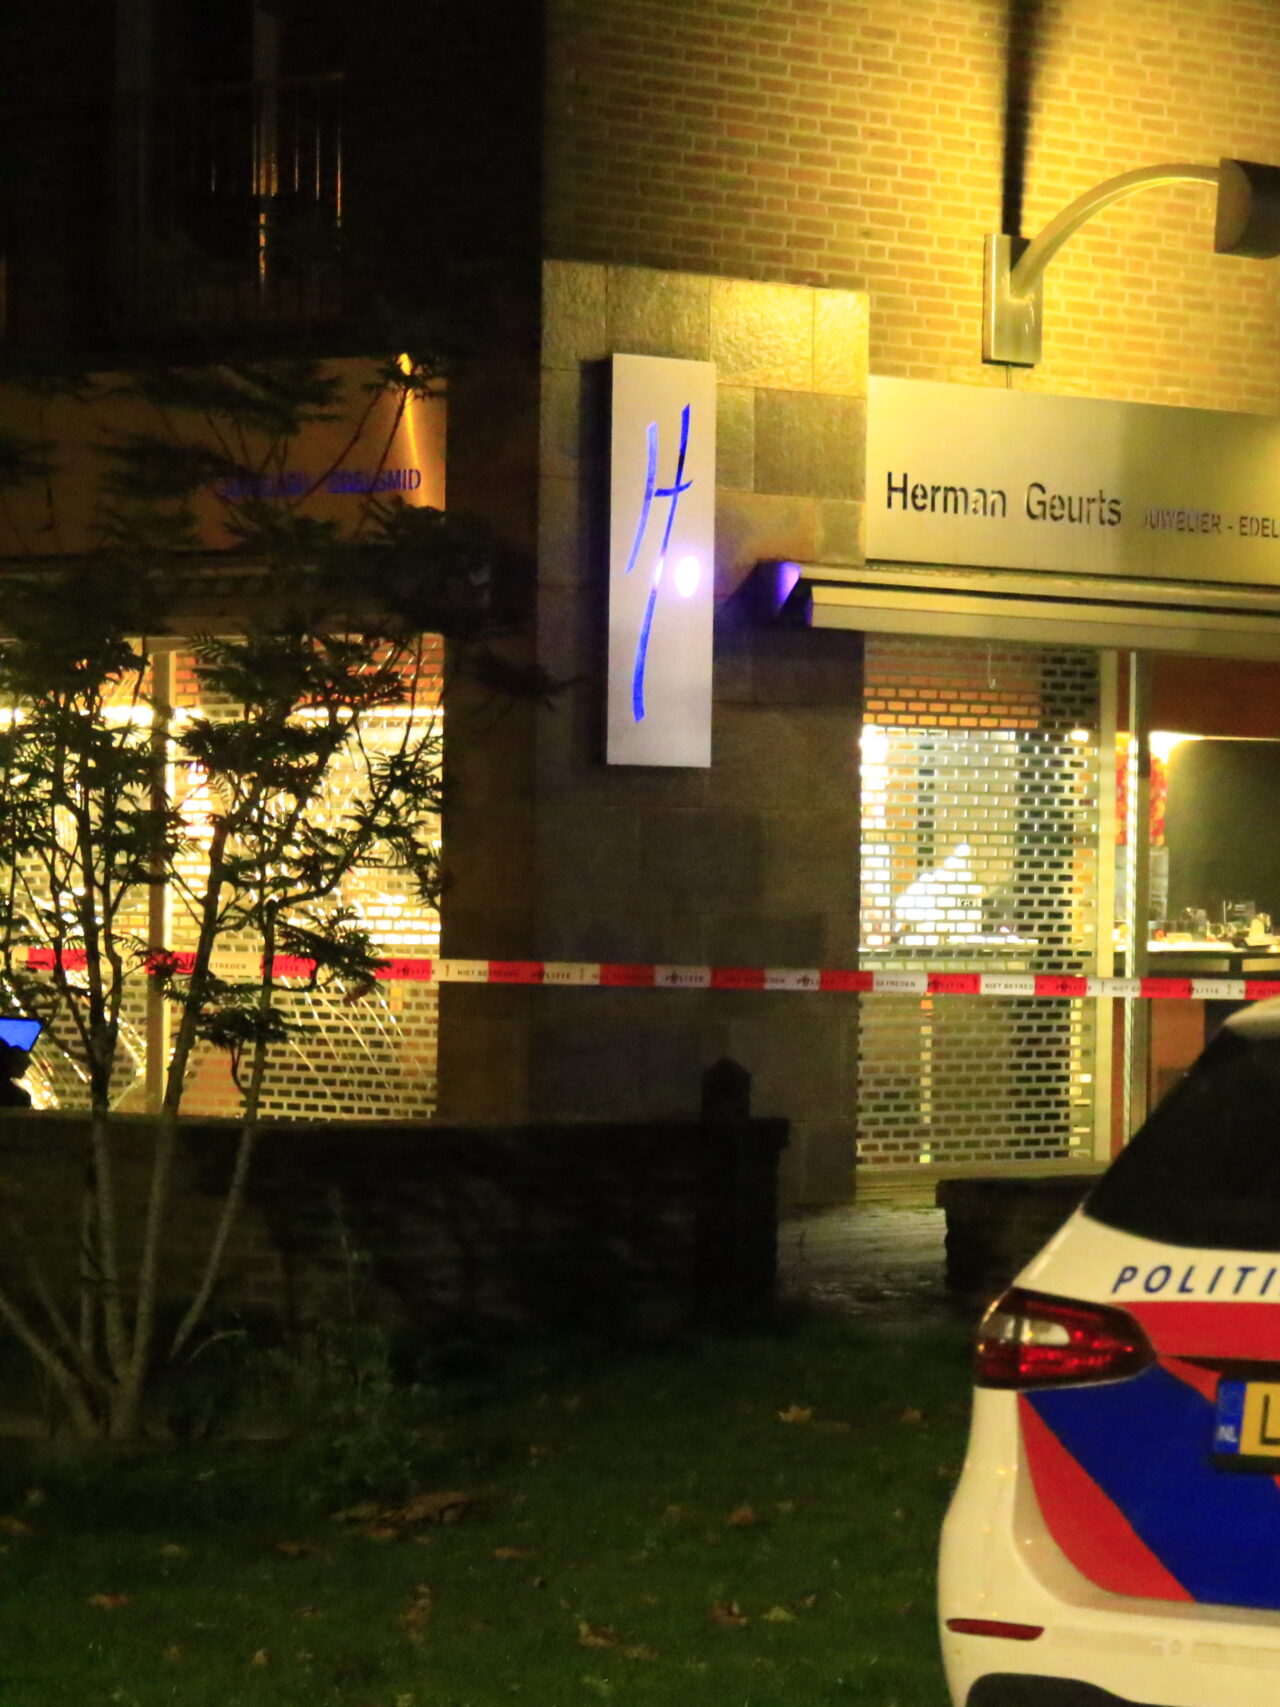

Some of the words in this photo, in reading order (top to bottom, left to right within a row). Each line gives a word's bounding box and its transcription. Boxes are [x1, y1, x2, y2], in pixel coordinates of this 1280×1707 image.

[886, 471, 1006, 518] Herman
[1024, 482, 1122, 527] Geurts
[1144, 508, 1222, 534] JUWELIER
[209, 962, 247, 970] ETREDEN
[1215, 1424, 1238, 1443] NL
